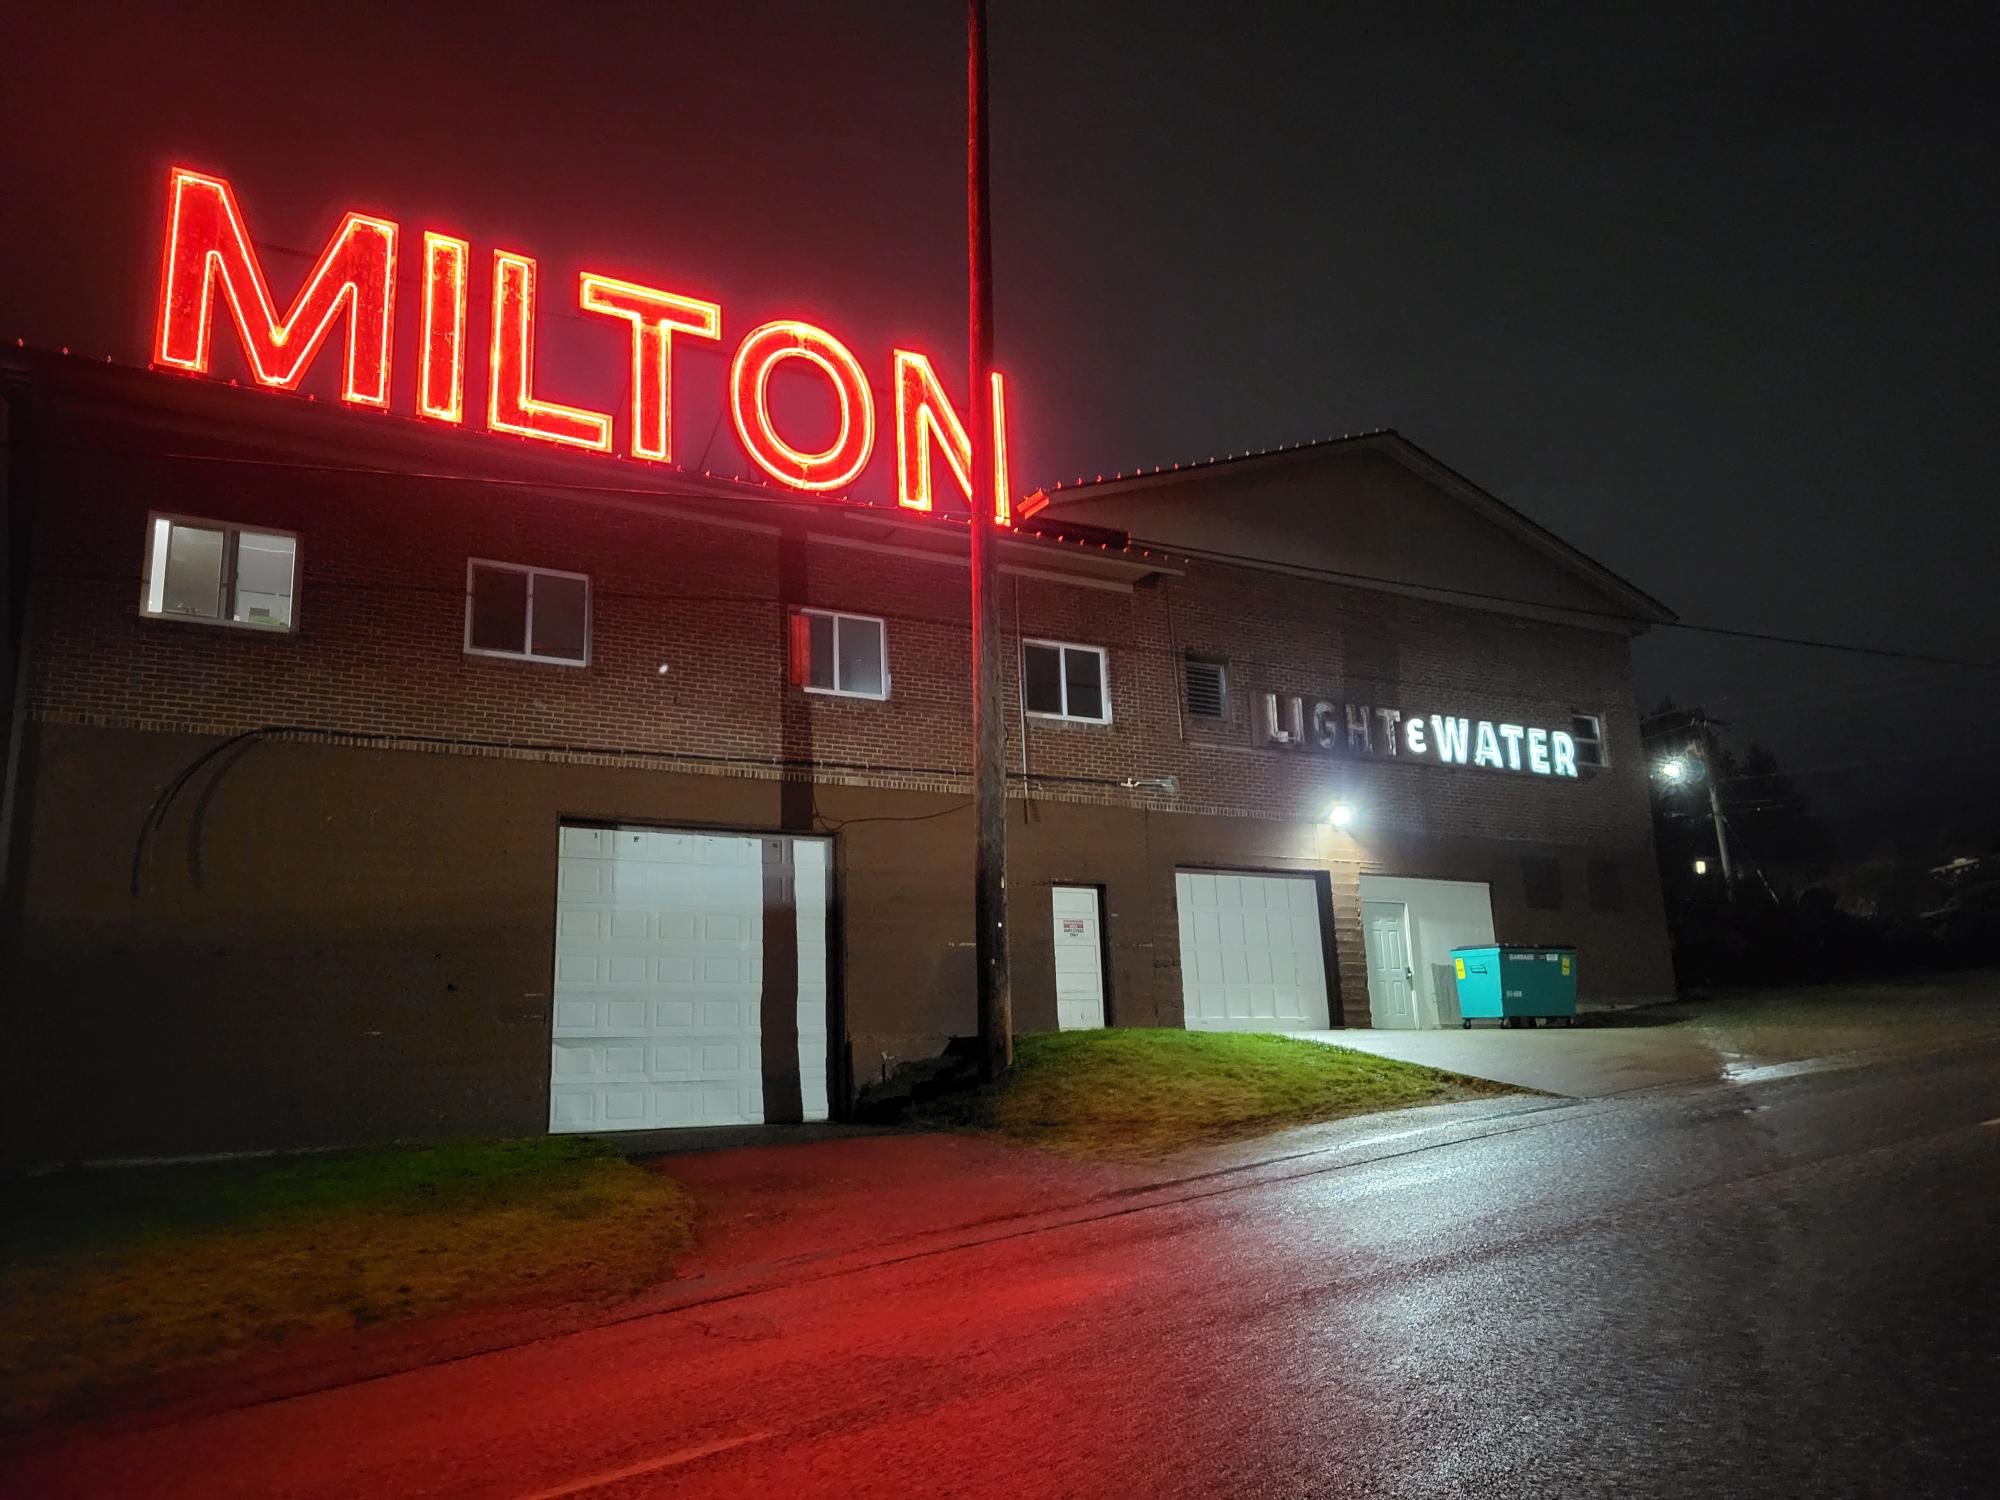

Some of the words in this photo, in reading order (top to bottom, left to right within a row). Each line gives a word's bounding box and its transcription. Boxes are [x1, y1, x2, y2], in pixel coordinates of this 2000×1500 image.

[153, 166, 1011, 527] MILTON
[1265, 694, 1400, 756] LIGHT
[1430, 714, 1578, 778] WATER
